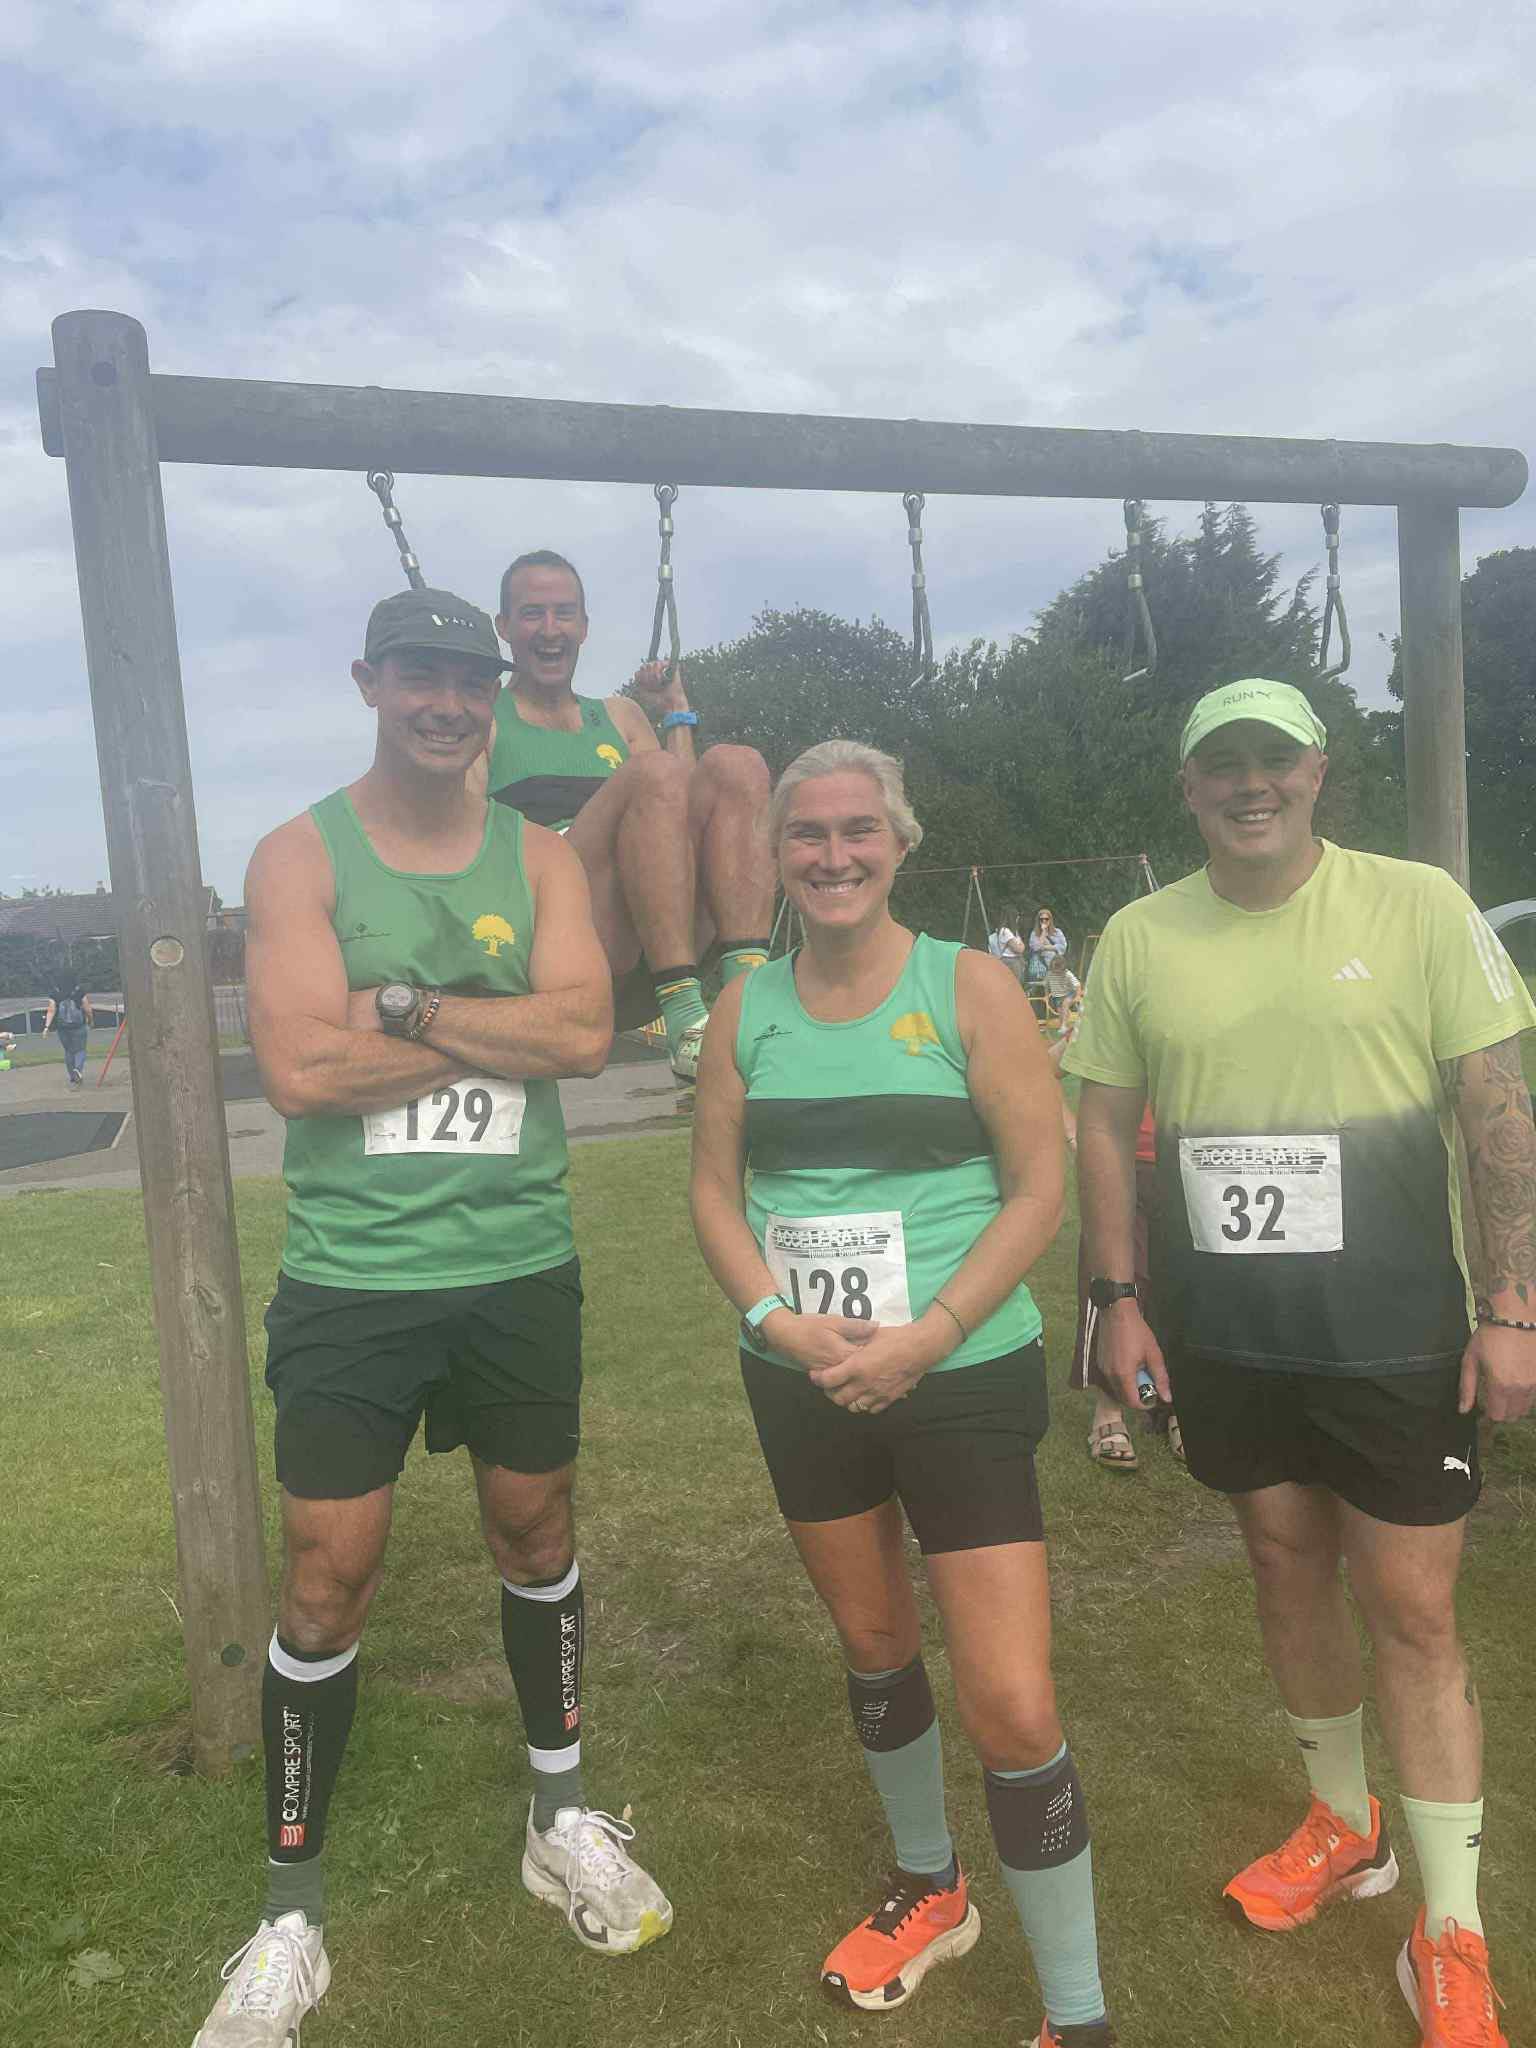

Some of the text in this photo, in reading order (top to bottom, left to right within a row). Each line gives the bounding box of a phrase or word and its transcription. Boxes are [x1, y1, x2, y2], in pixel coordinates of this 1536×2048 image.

[407, 1088, 493, 1142] 129
[1222, 1185, 1286, 1241] 32
[790, 1267, 872, 1320] 128
[561, 1615, 577, 1710] COMPRESPORT
[282, 1710, 302, 1822] COMPRESPORT
